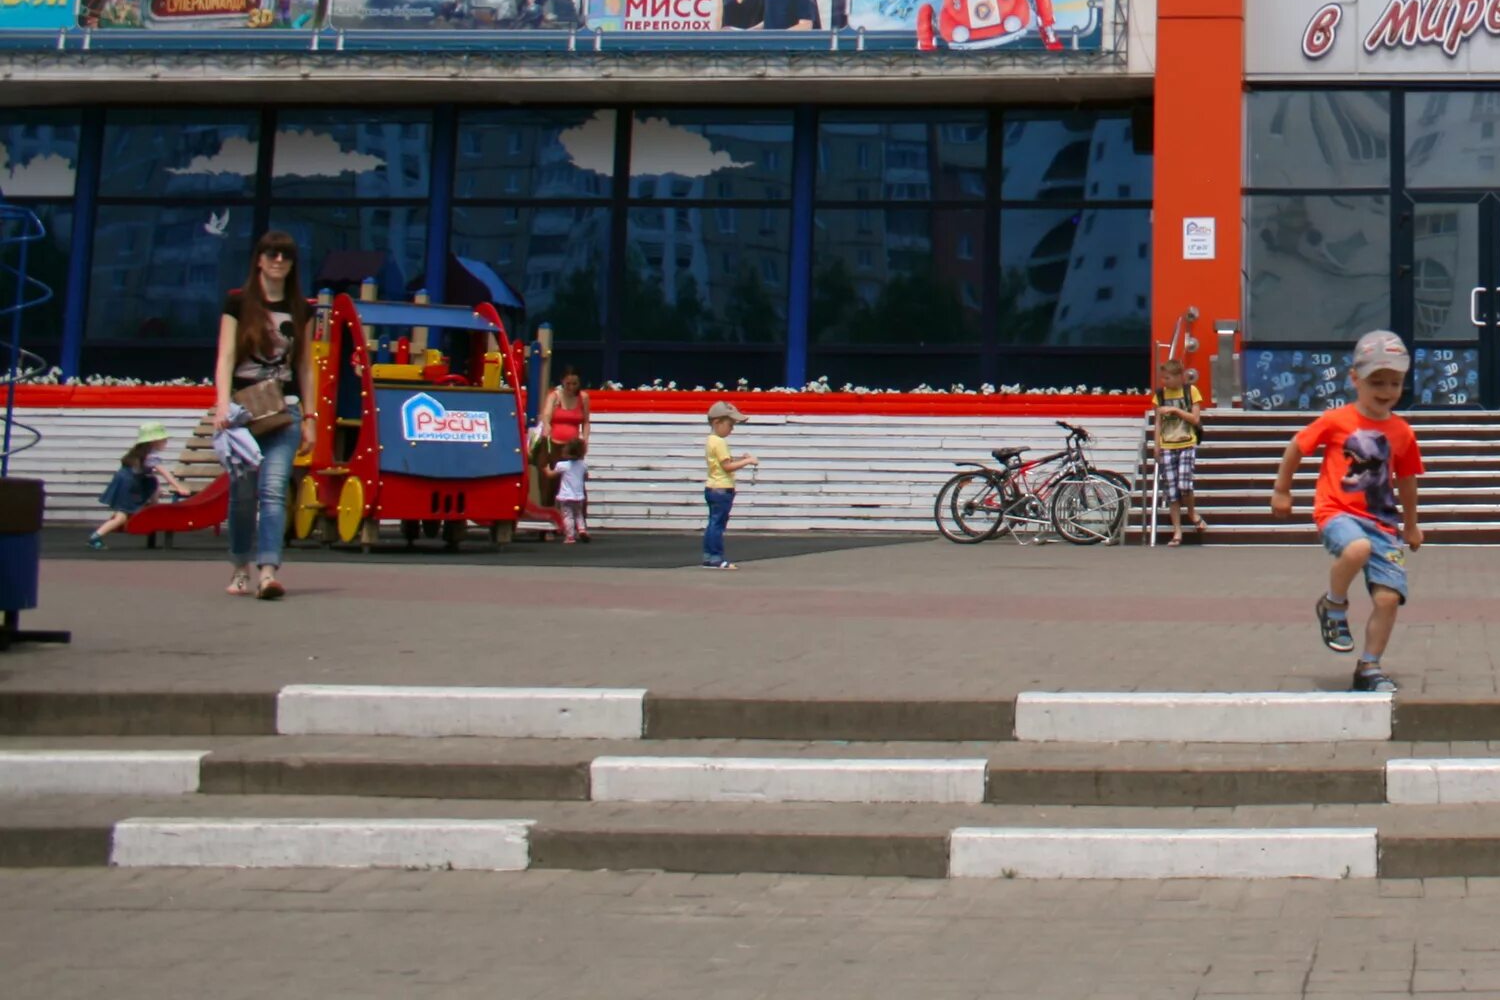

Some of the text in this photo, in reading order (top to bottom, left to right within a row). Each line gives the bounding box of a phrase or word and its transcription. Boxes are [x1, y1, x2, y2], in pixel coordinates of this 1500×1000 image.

[248, 8, 275, 27] 3D
[624, 20, 711, 30] ПЕРЕПОЛОХ
[1301, 3, 1342, 59] в
[1312, 354, 1332, 365] 3D
[1434, 350, 1453, 361] 3D
[1315, 381, 1336, 397] 3D
[1261, 394, 1284, 410] 3D
[1448, 394, 1467, 404] 3D
